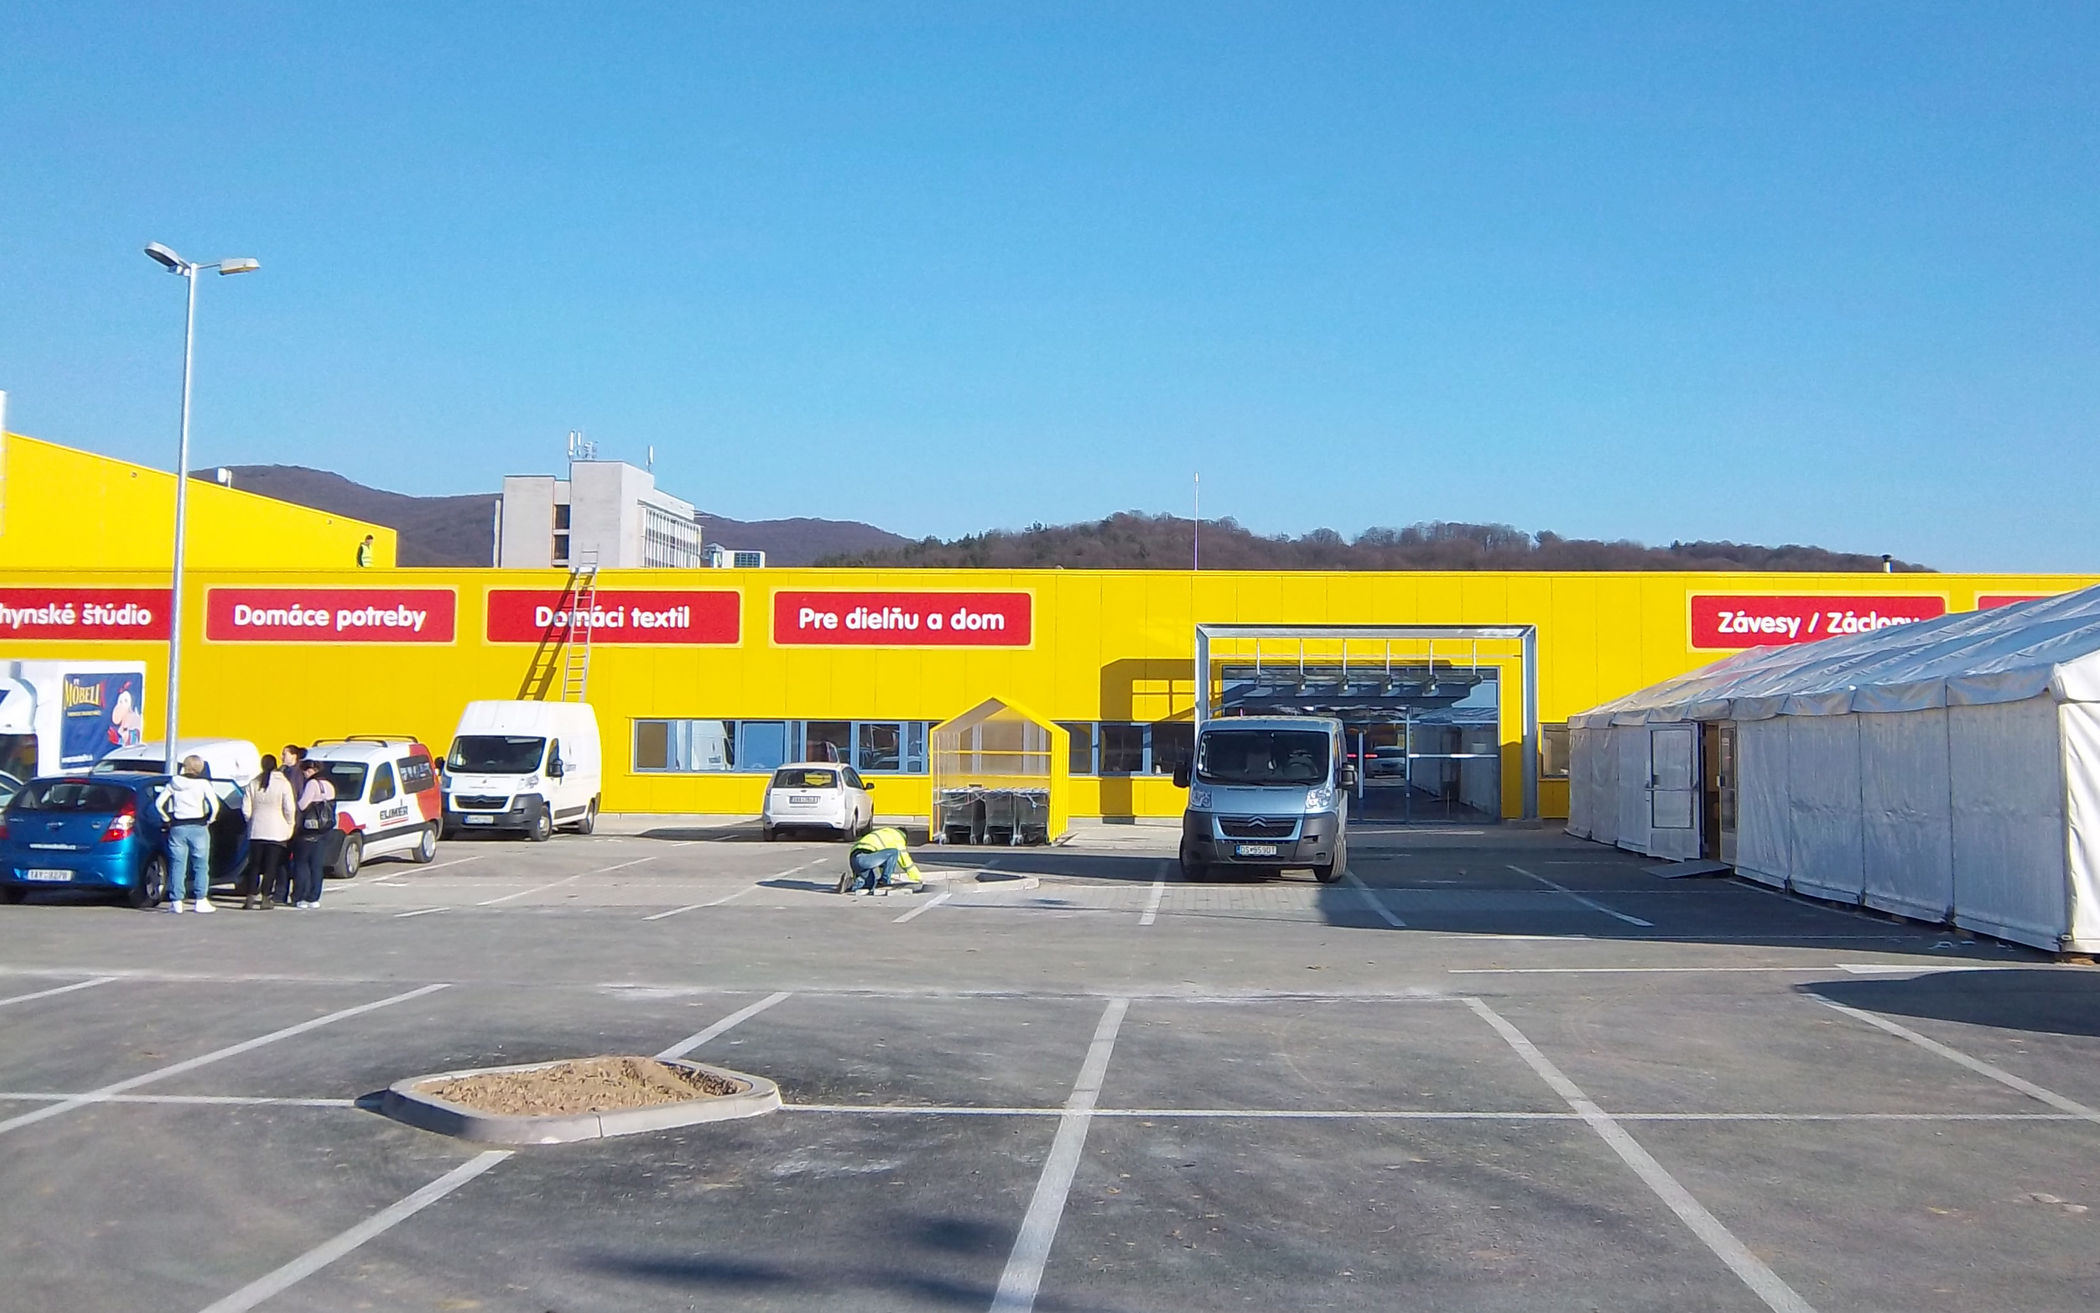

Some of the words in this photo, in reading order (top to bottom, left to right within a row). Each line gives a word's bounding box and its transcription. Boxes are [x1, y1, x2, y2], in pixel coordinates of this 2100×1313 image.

[0, 602, 76, 630] hynské
[82, 603, 152, 626] štúdio
[234, 603, 330, 627] Domáce
[336, 604, 427, 632] potreby
[535, 605, 625, 628] Domáci
[631, 605, 690, 628] textil
[799, 607, 839, 630] Pre
[845, 606, 919, 630] dielňu
[926, 613, 943, 630] a
[950, 607, 1005, 630] dom
[1717, 611, 1801, 639] Závesy
[1807, 612, 1820, 634] /
